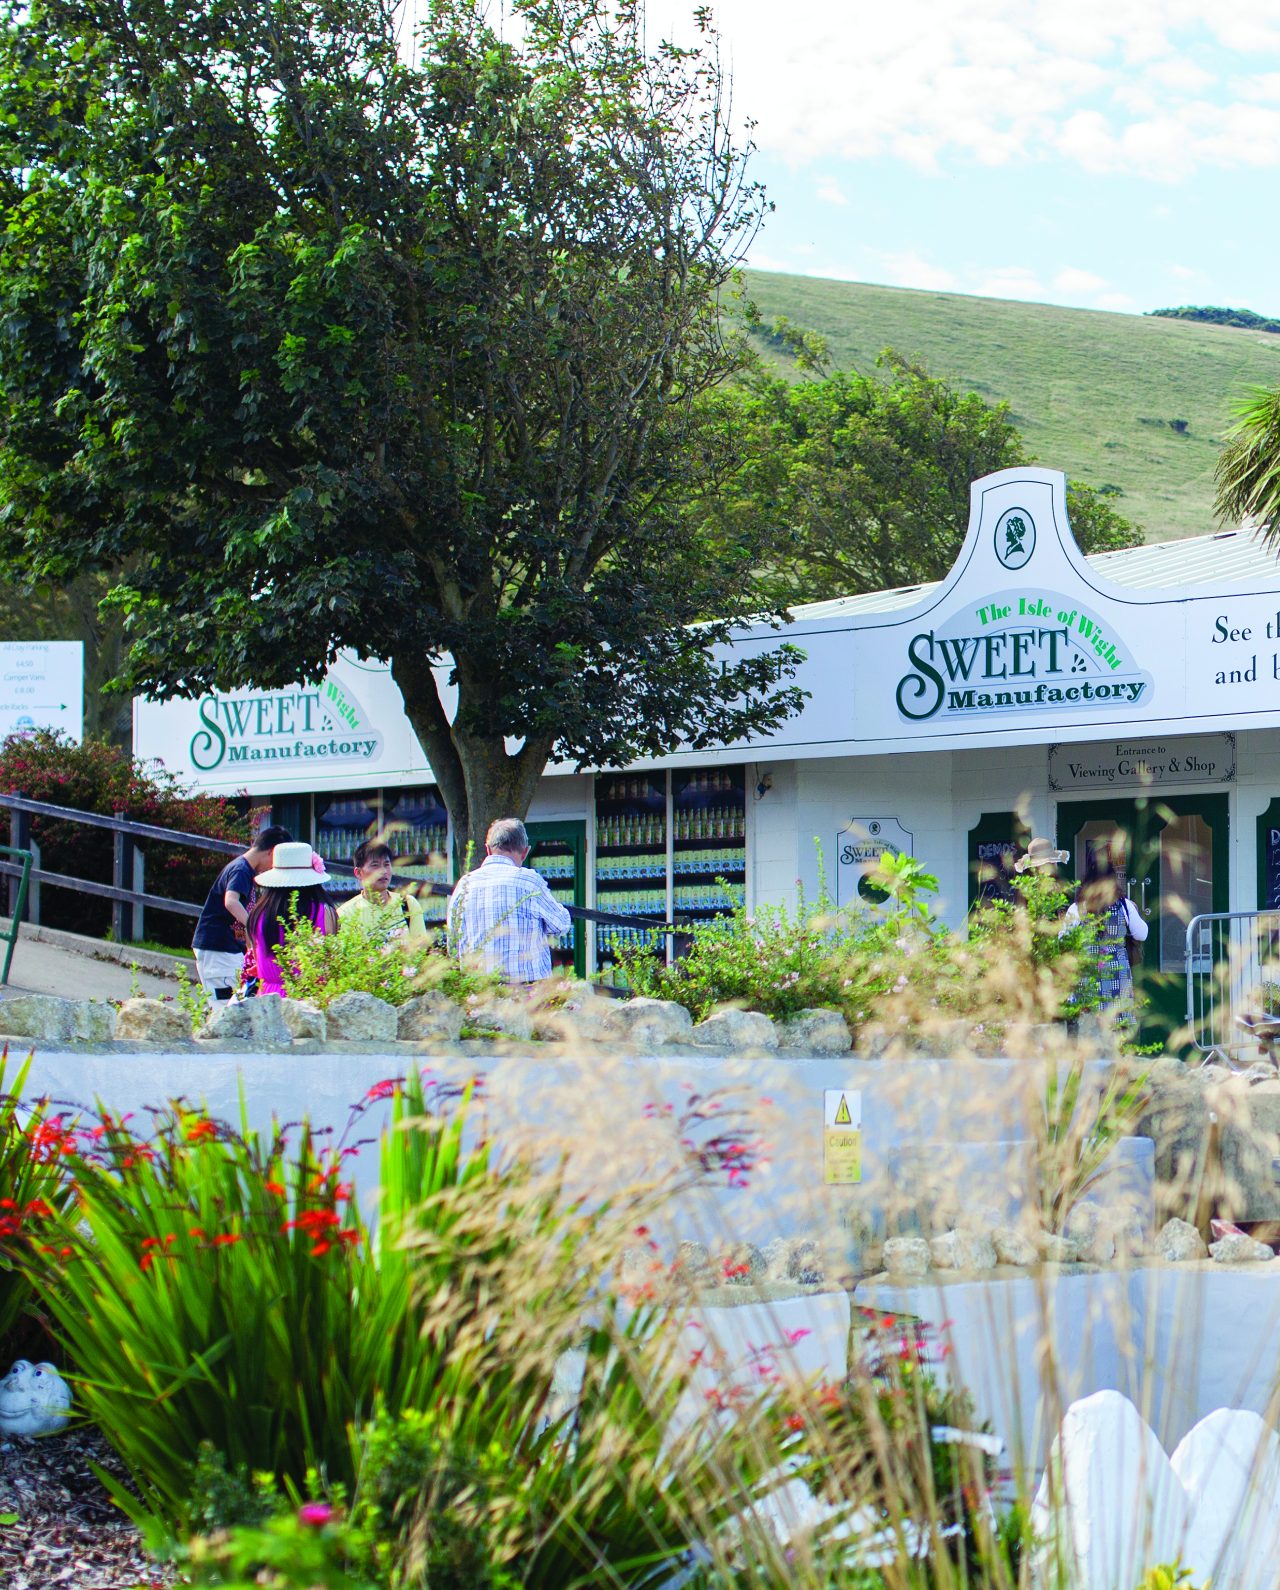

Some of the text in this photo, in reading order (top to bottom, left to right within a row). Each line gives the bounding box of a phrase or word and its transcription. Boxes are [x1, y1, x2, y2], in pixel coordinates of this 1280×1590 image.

[976, 598, 1123, 670] The Isle of Wight
[1212, 615, 1252, 643] See
[896, 627, 1069, 719] SWEET
[1215, 655, 1257, 684] and
[947, 681, 1146, 711] Manufactory
[190, 692, 320, 771] SWEET
[228, 738, 377, 762] Manufactory
[1116, 745, 1166, 756] Entrance to
[1067, 756, 1216, 781] Viewing Gallery & Shop
